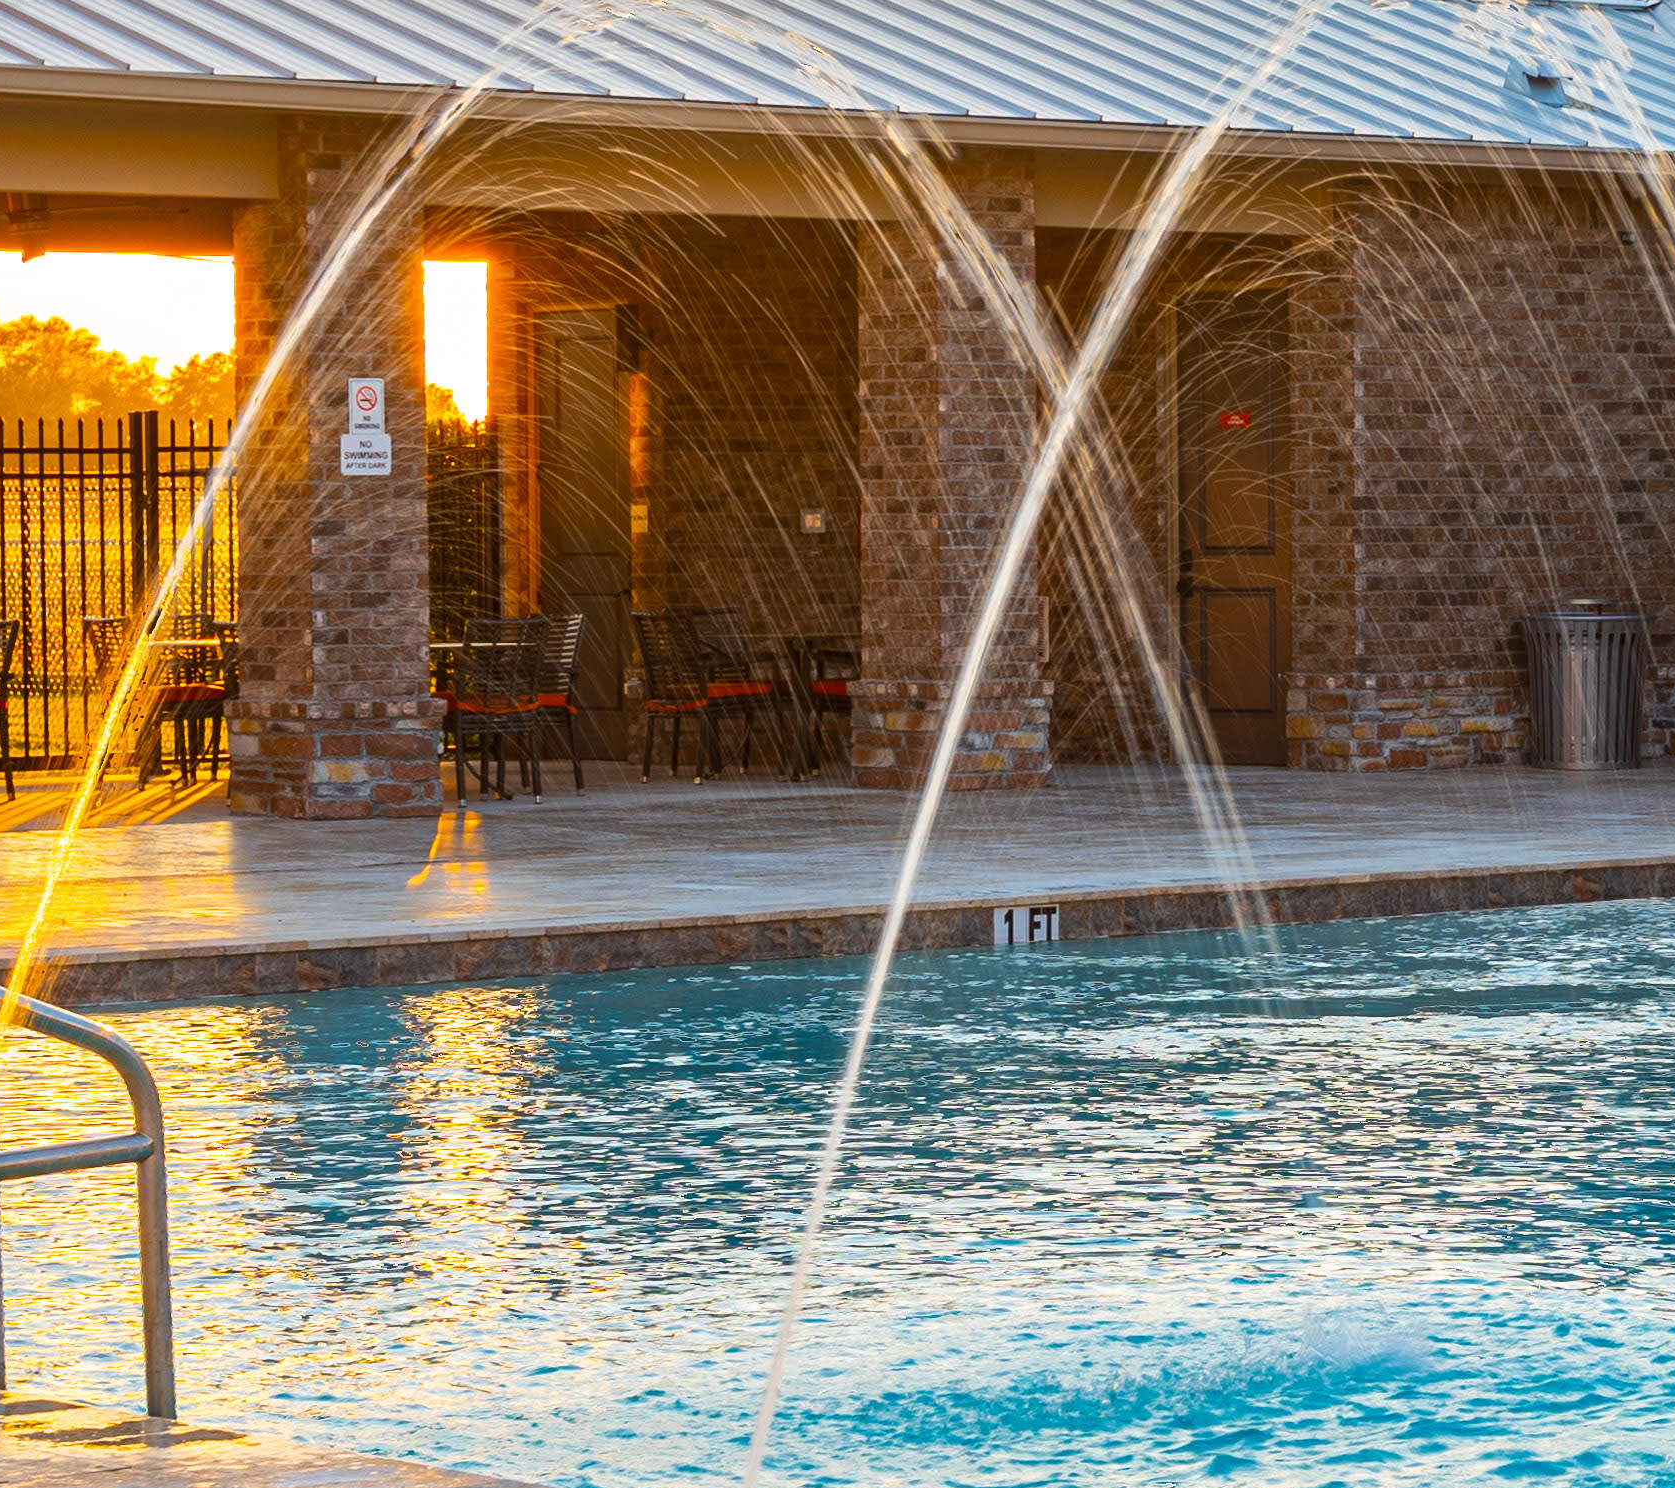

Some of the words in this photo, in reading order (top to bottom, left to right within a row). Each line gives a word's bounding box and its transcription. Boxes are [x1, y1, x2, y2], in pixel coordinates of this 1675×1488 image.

[359, 440, 372, 448] NO
[344, 452, 388, 460] SWIMMING
[1004, 909, 1014, 944] 1
[1029, 906, 1057, 942] FT
